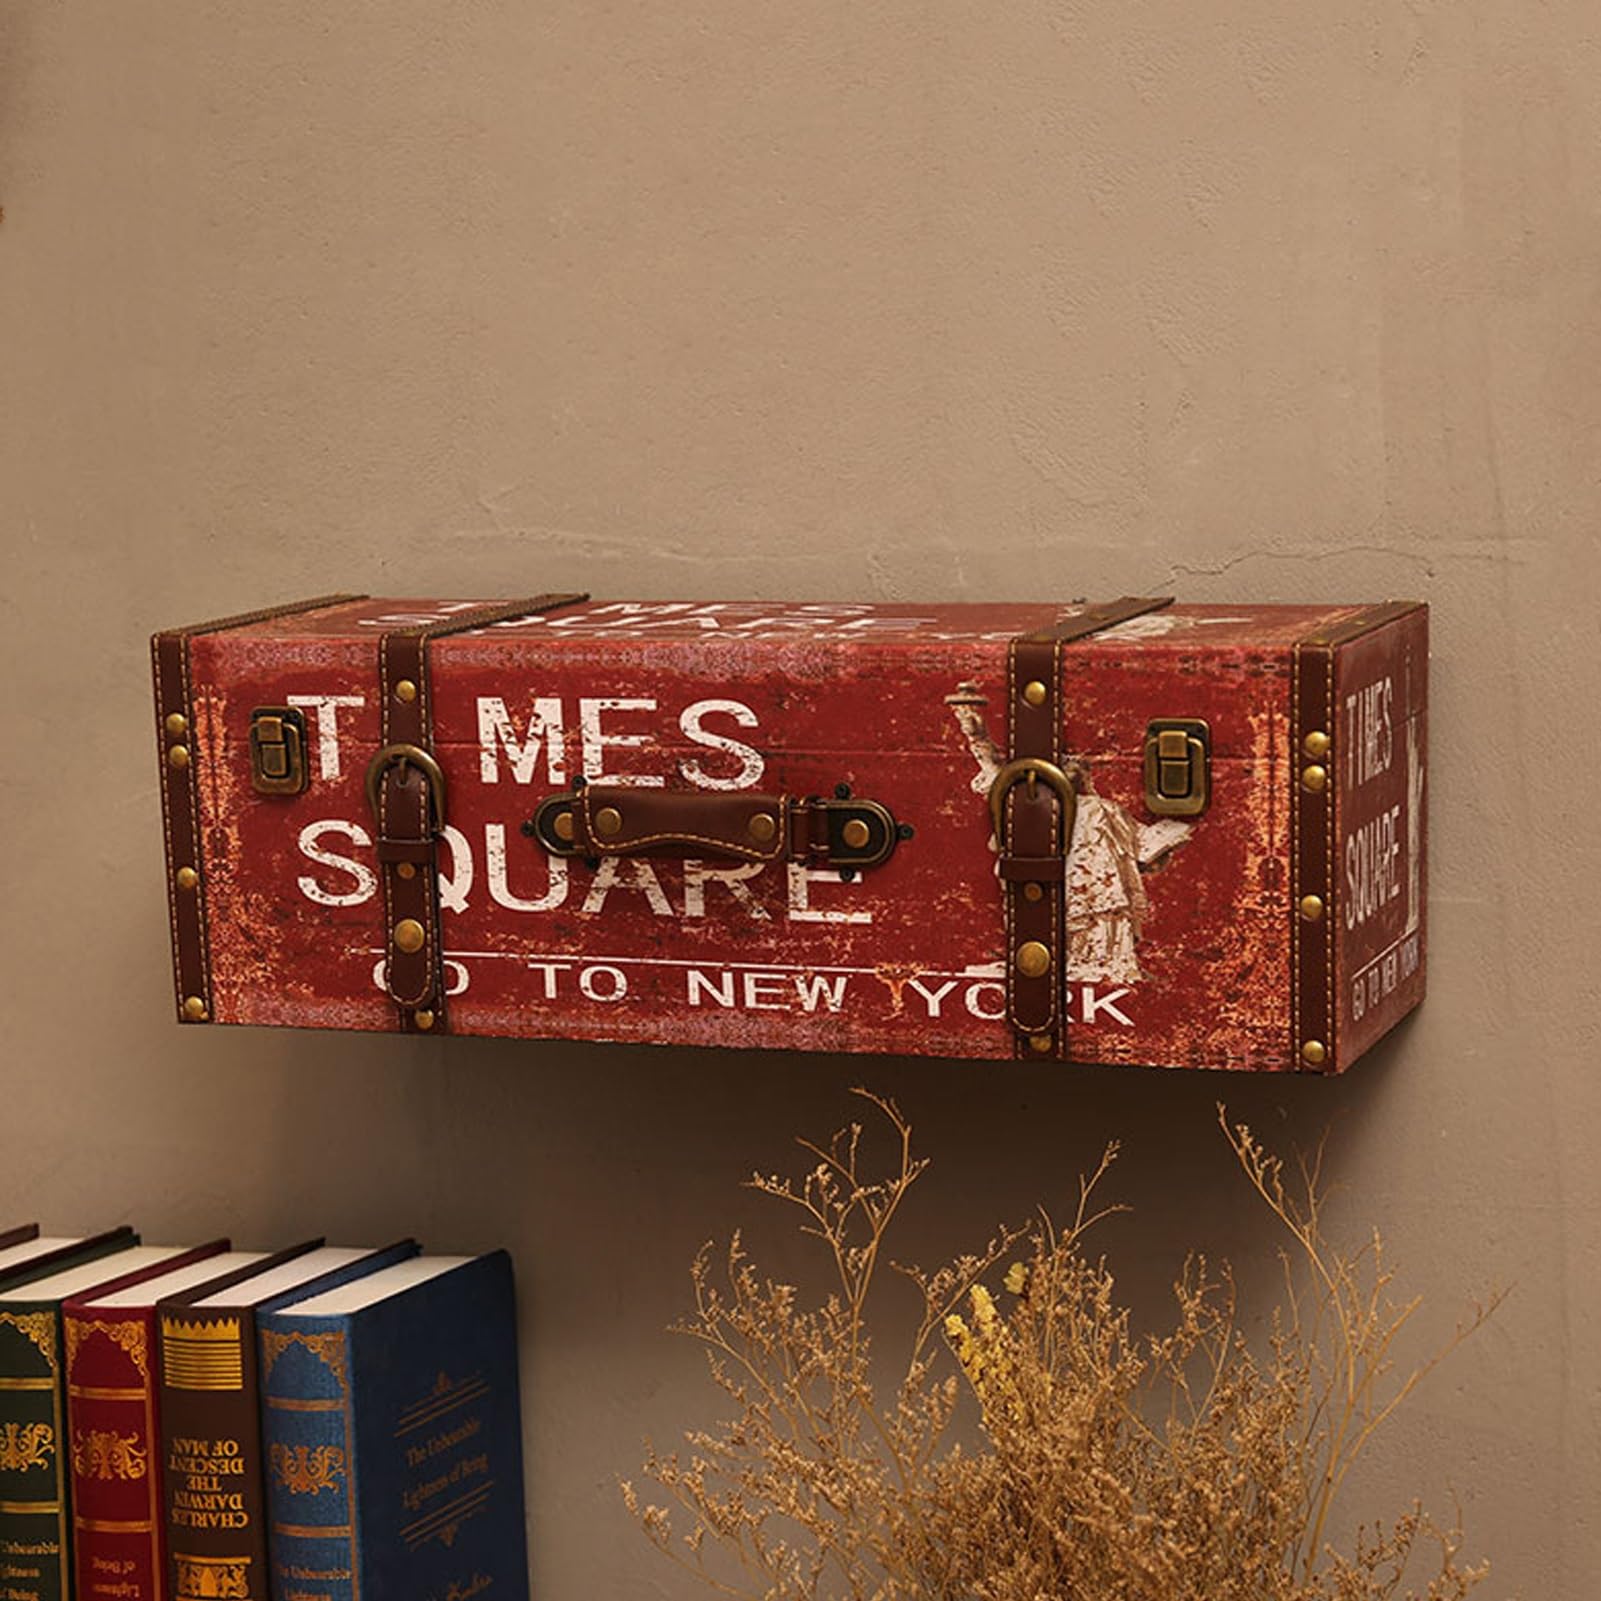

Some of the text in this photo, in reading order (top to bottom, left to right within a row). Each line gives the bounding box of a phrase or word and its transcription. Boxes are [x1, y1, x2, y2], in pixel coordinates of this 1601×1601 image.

[438, 600, 876, 616] TMES
[358, 614, 937, 630] SUARE
[1346, 676, 1393, 790] TIMES
[287, 695, 766, 792] TMES
[1346, 804, 1400, 931] SQUARE
[527, 963, 628, 1001] TO
[687, 969, 849, 1013] NEW
[907, 979, 1136, 1027] YOK
[172, 1437, 240, 1457] OF MAN
[168, 1455, 245, 1475] DESCENT
[186, 1475, 223, 1492] THE
[173, 1490, 243, 1511] DARWIN
[172, 1509, 249, 1529] CHARLES
